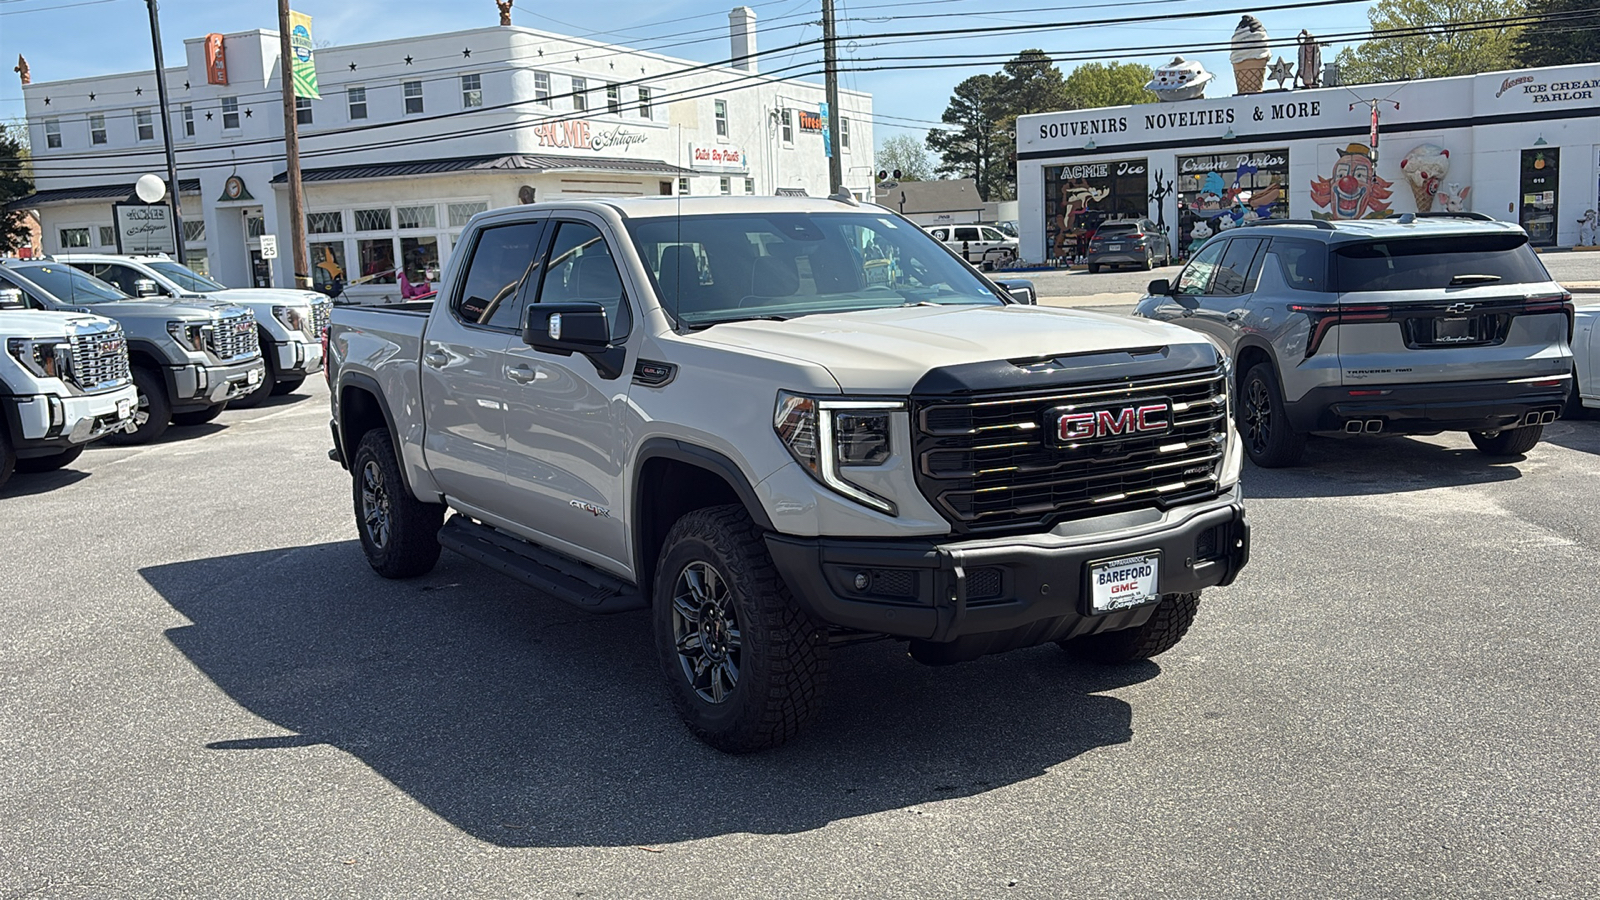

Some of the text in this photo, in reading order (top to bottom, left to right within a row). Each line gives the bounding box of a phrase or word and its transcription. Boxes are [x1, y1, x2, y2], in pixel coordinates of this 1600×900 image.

[214, 37, 225, 81] ACME
[1523, 80, 1600, 94] ICE CREAM
[1533, 91, 1592, 103] PARLOR
[1040, 101, 1321, 139] SOUVENIRS NOVELTIES & MORE
[533, 119, 591, 150] ACME
[695, 148, 739, 164] Dutch Boy Paints
[1181, 154, 1286, 173] Cream Parlor
[1060, 162, 1146, 180] ACME Ice
[263, 247, 276, 256] 25
[1057, 404, 1168, 441] GMC
[569, 499, 611, 519] AT4X
[1099, 565, 1152, 585] BAREFORD
[1111, 581, 1139, 594] GMC
